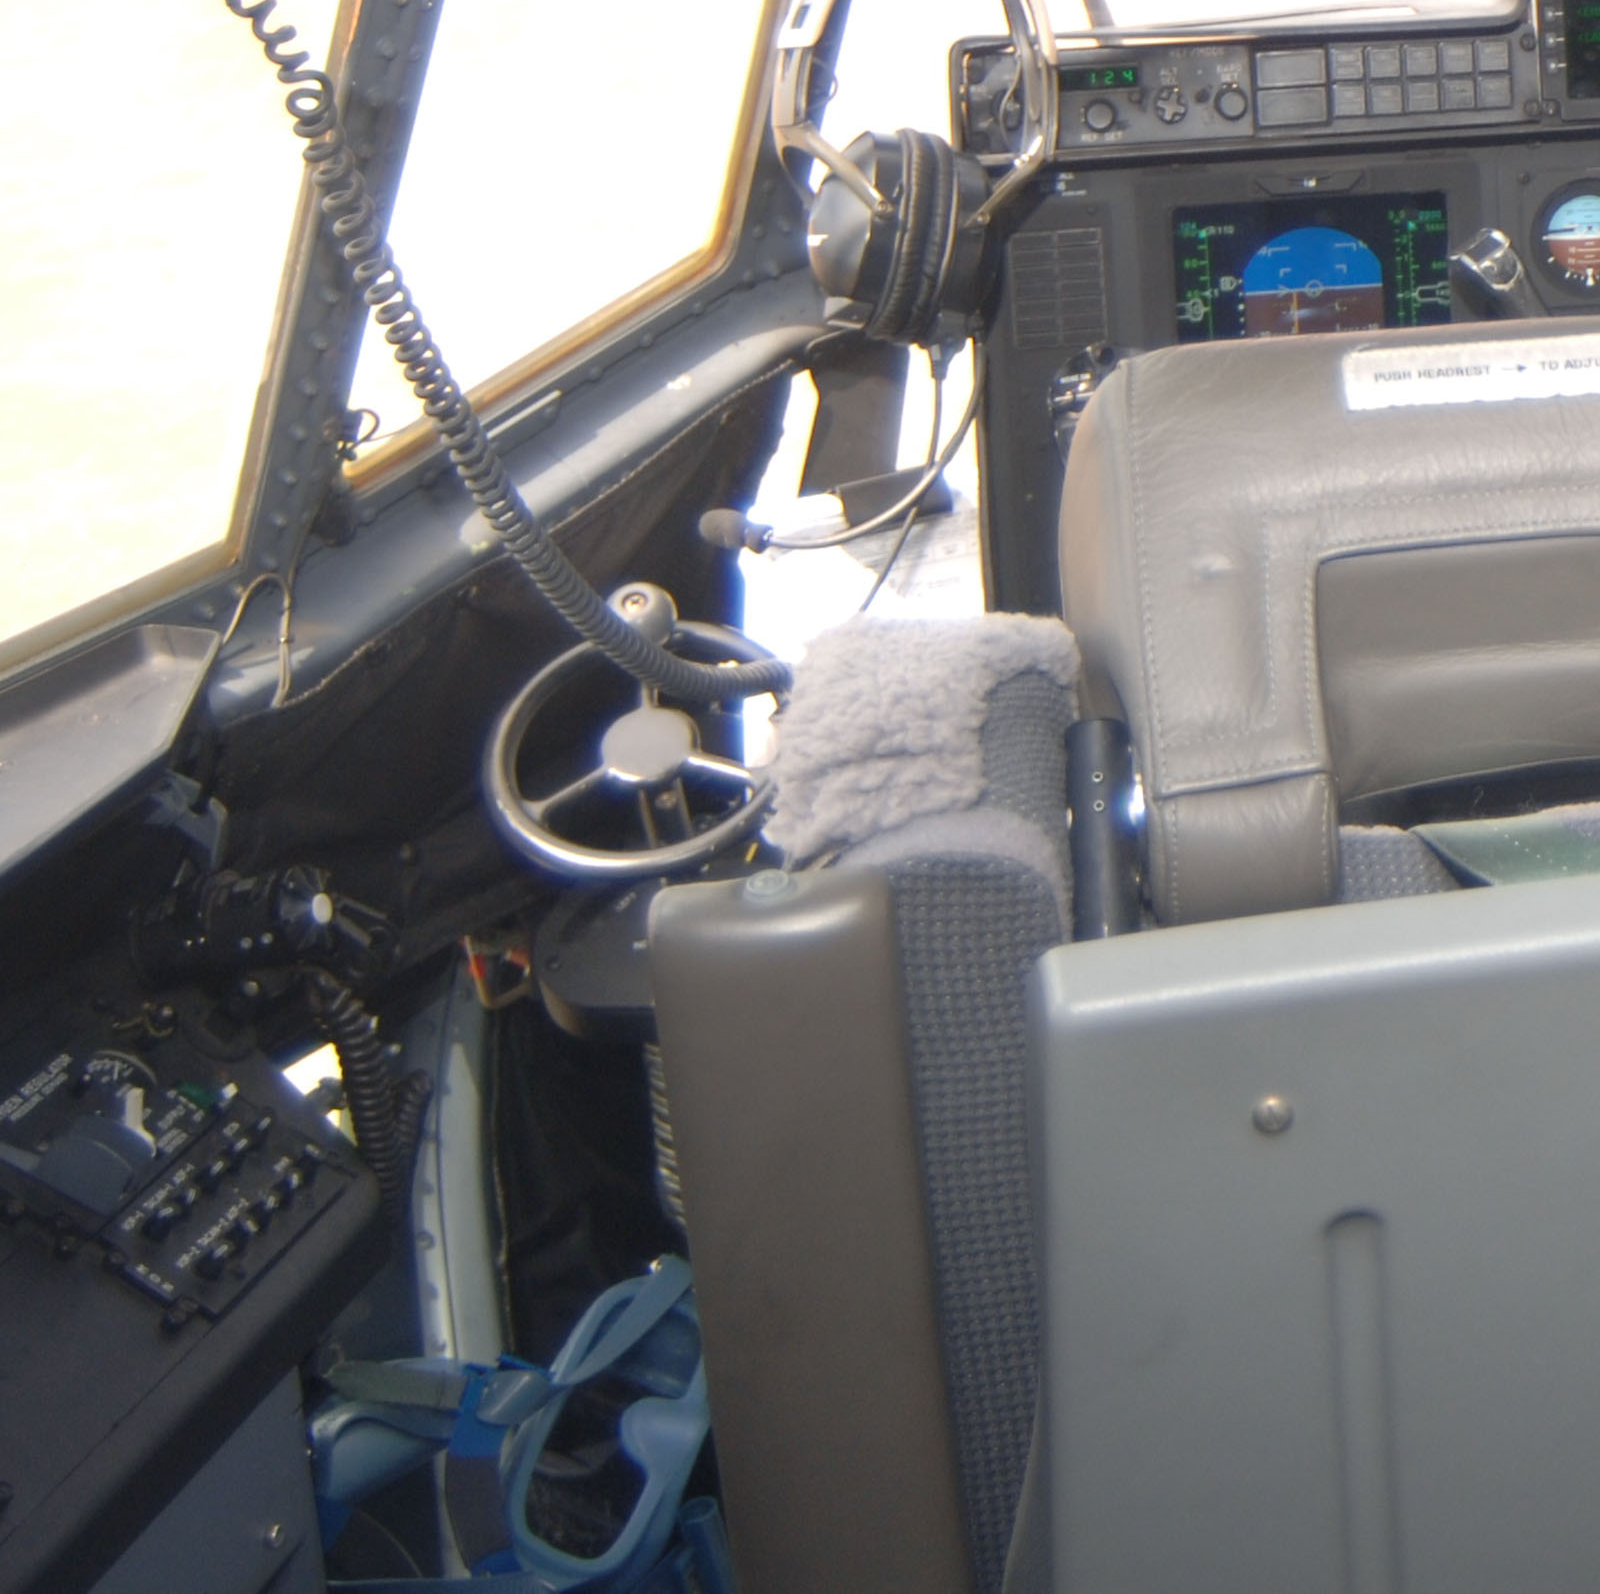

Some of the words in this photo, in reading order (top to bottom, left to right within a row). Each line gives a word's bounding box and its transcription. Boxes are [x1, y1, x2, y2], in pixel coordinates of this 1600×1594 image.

[1374, 370, 1412, 383] PUSH
[1418, 364, 1491, 379] HEADREST
[1539, 360, 1559, 371] TO
